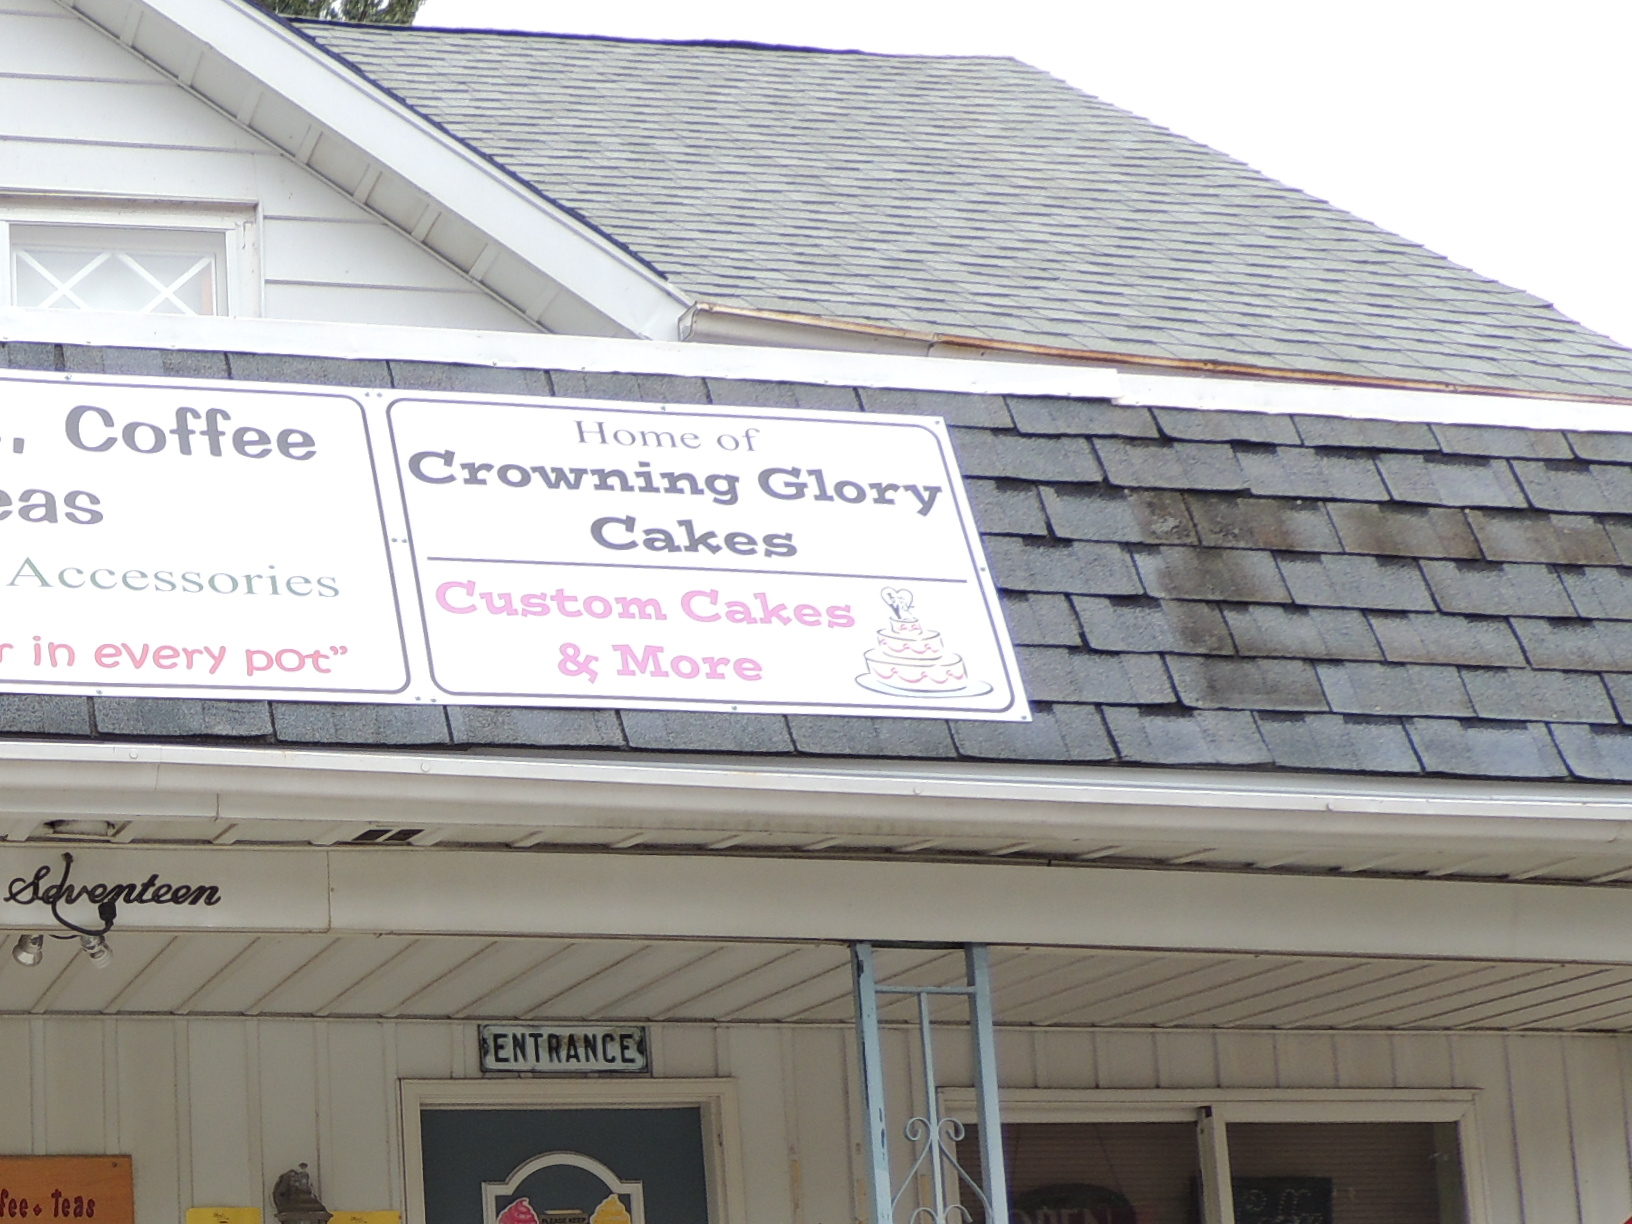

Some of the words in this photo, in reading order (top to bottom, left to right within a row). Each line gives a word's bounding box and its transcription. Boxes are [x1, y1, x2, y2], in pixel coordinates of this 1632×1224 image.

[65, 405, 317, 461] Coffee
[573, 420, 702, 450] Home
[716, 428, 761, 452] of
[407, 449, 740, 505] Crowning
[758, 466, 942, 518] Glory
[590, 516, 799, 558] Cakes
[5, 557, 340, 599] Accessories
[435, 579, 667, 622] Custom
[680, 589, 856, 629] Cakes
[32, 636, 76, 668] in
[93, 644, 226, 675] every
[557, 642, 599, 683] &
[612, 644, 763, 682] More
[3, 865, 222, 906] Seventeen
[492, 1031, 637, 1065] ENTRANCE
[50, 1187, 96, 1219] Teas
[542, 1217, 567, 1224] PLEASE
[568, 1217, 586, 1224] KEEP
